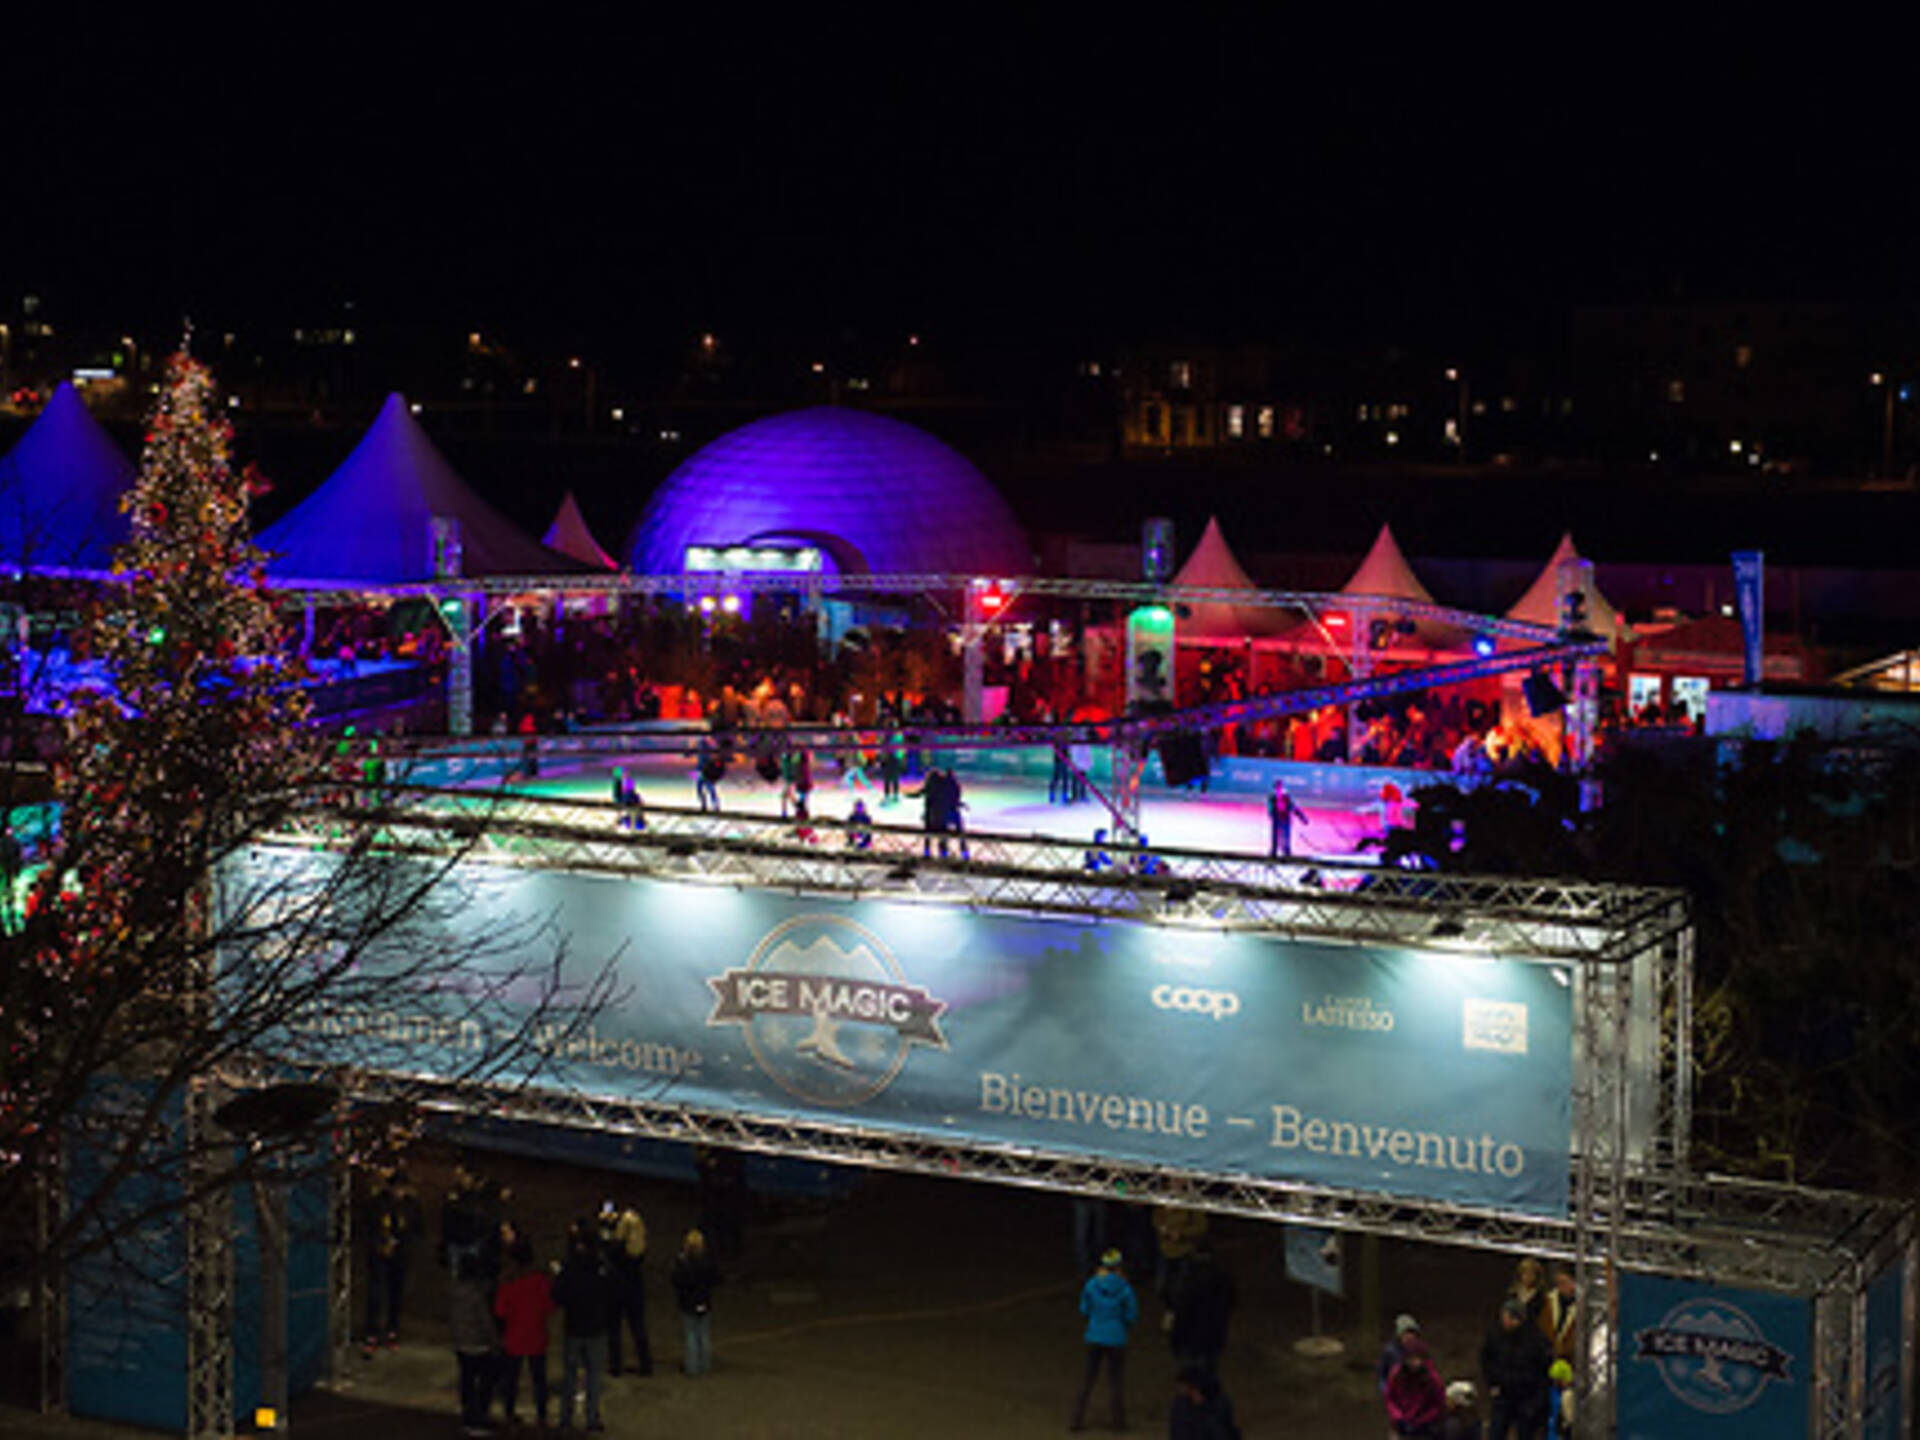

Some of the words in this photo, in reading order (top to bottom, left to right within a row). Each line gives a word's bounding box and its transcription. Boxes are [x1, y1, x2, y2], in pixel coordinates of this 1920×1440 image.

[736, 979, 789, 1008] ICE
[799, 981, 912, 1022] MAGIC
[1151, 985, 1240, 1020] coop
[536, 1022, 703, 1077] Welcome
[979, 1071, 1209, 1138] Bienvenue
[1269, 1104, 1525, 1177] Benvenuto
[1654, 1333, 1687, 1352] ICE
